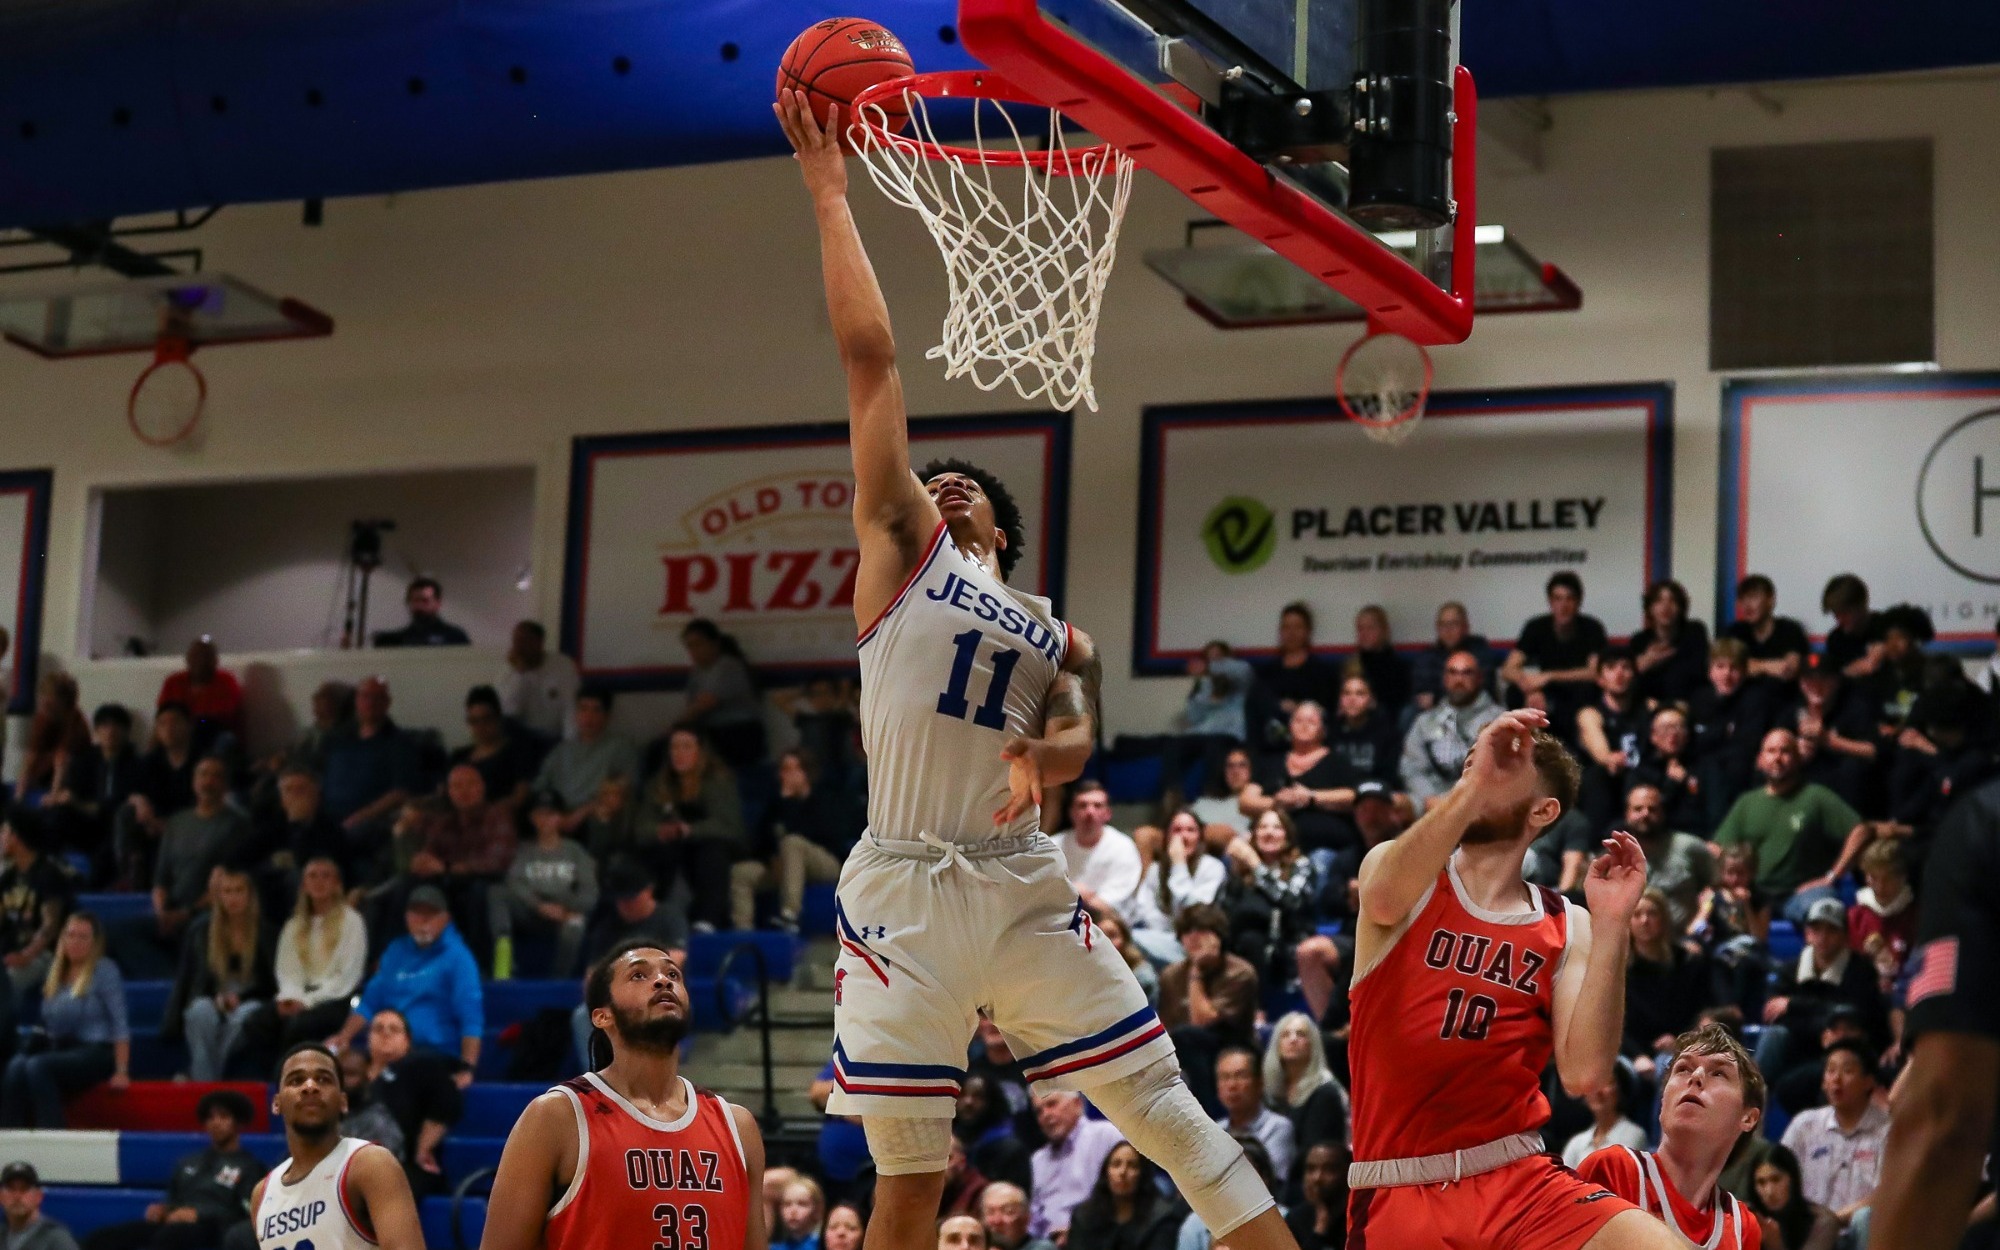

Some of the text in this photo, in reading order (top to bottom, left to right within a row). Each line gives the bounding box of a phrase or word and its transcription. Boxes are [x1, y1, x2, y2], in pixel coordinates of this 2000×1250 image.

[702, 481, 854, 536] OLD TO
[1291, 497, 1607, 540] PLACER VALLEY
[658, 548, 860, 616] PIZZ
[1926, 602, 1999, 620] IGH
[936, 628, 1021, 731] 11
[1424, 928, 1547, 996] OUAZ
[1440, 987, 1498, 1040] 10
[624, 1148, 724, 1193] OUAZ
[259, 1200, 326, 1242] JESSUP
[652, 1203, 709, 1250] 33
